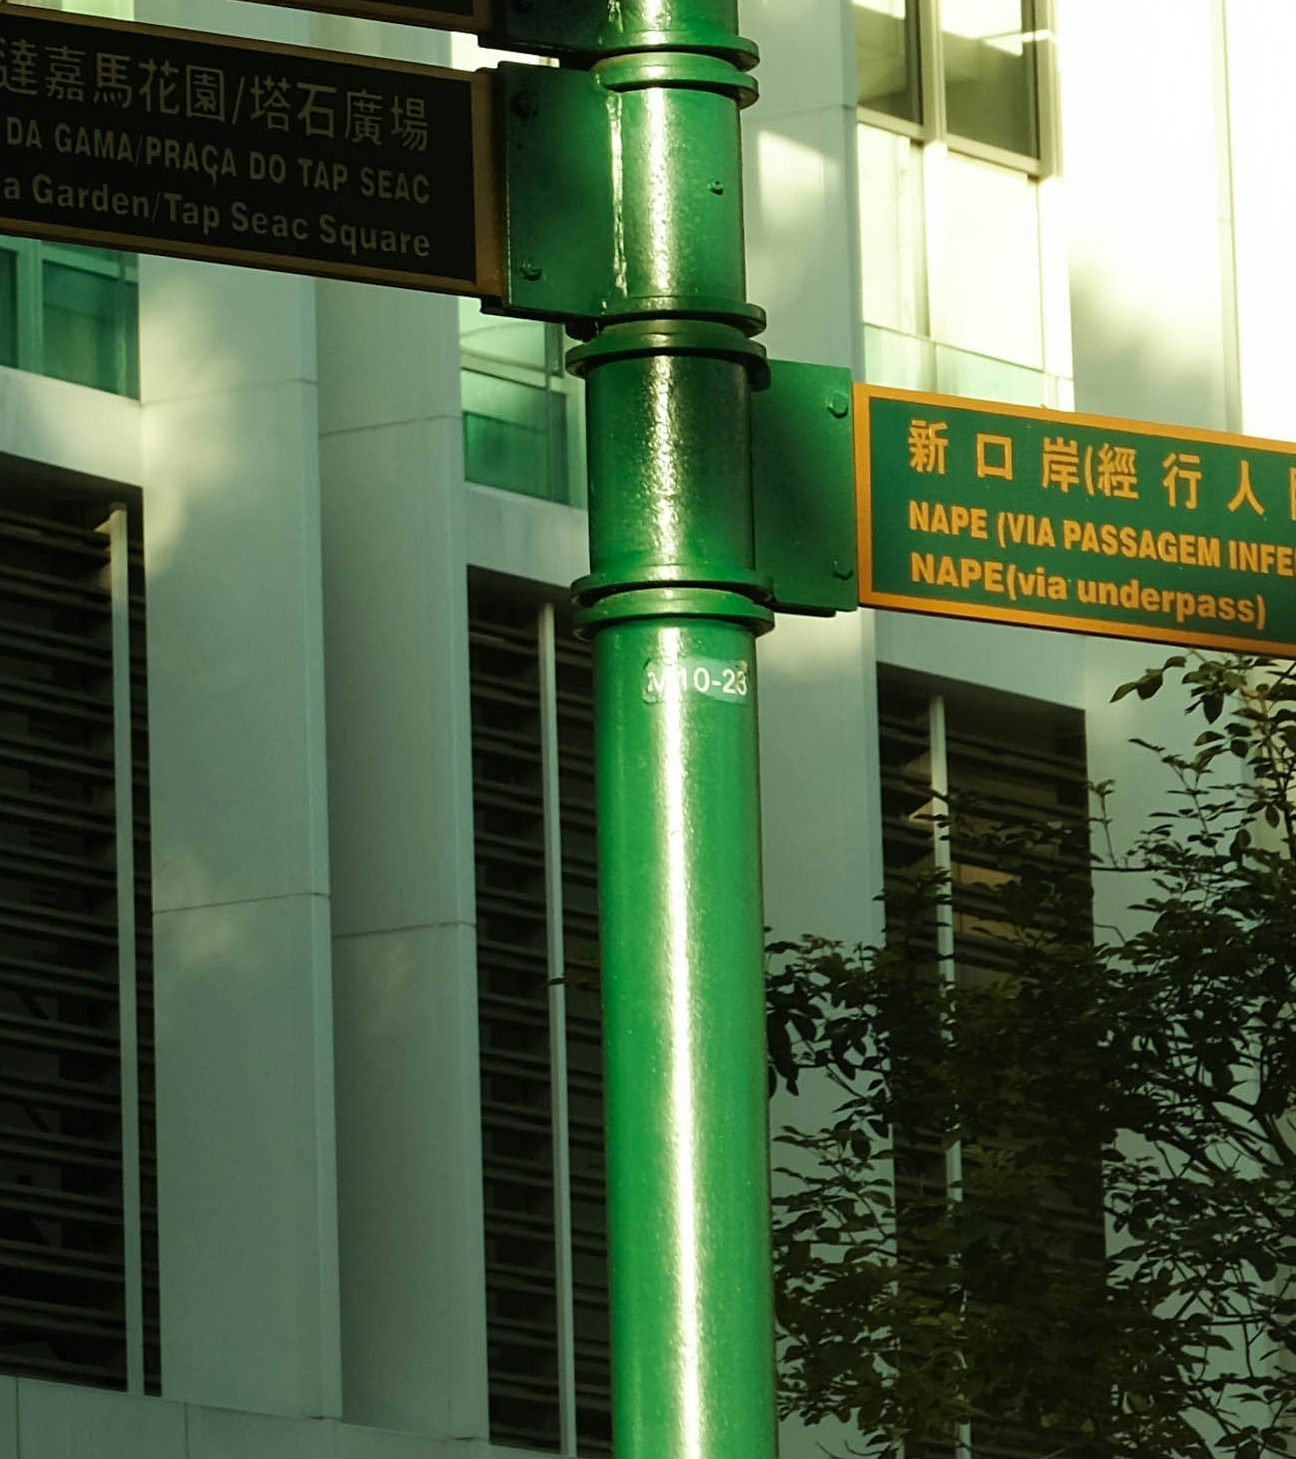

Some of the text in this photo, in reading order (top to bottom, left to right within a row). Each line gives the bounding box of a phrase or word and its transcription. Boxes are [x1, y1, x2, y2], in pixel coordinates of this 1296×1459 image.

[6, 115, 44, 149] DA
[54, 122, 238, 183] GAMA/PRAÇA
[249, 151, 287, 183] DO
[298, 157, 349, 191] TAP
[360, 166, 431, 205] SEAC
[31, 173, 221, 234] Garden/Tap
[231, 200, 309, 240] Seac
[318, 213, 431, 257] Square
[908, 418, 1296, 521] 新口岸(經行人
[908, 500, 989, 539] NAPE
[997, 511, 1057, 548] (VIA
[1063, 518, 1222, 568] PASSAGEM
[1077, 575, 1267, 630] underpass)
